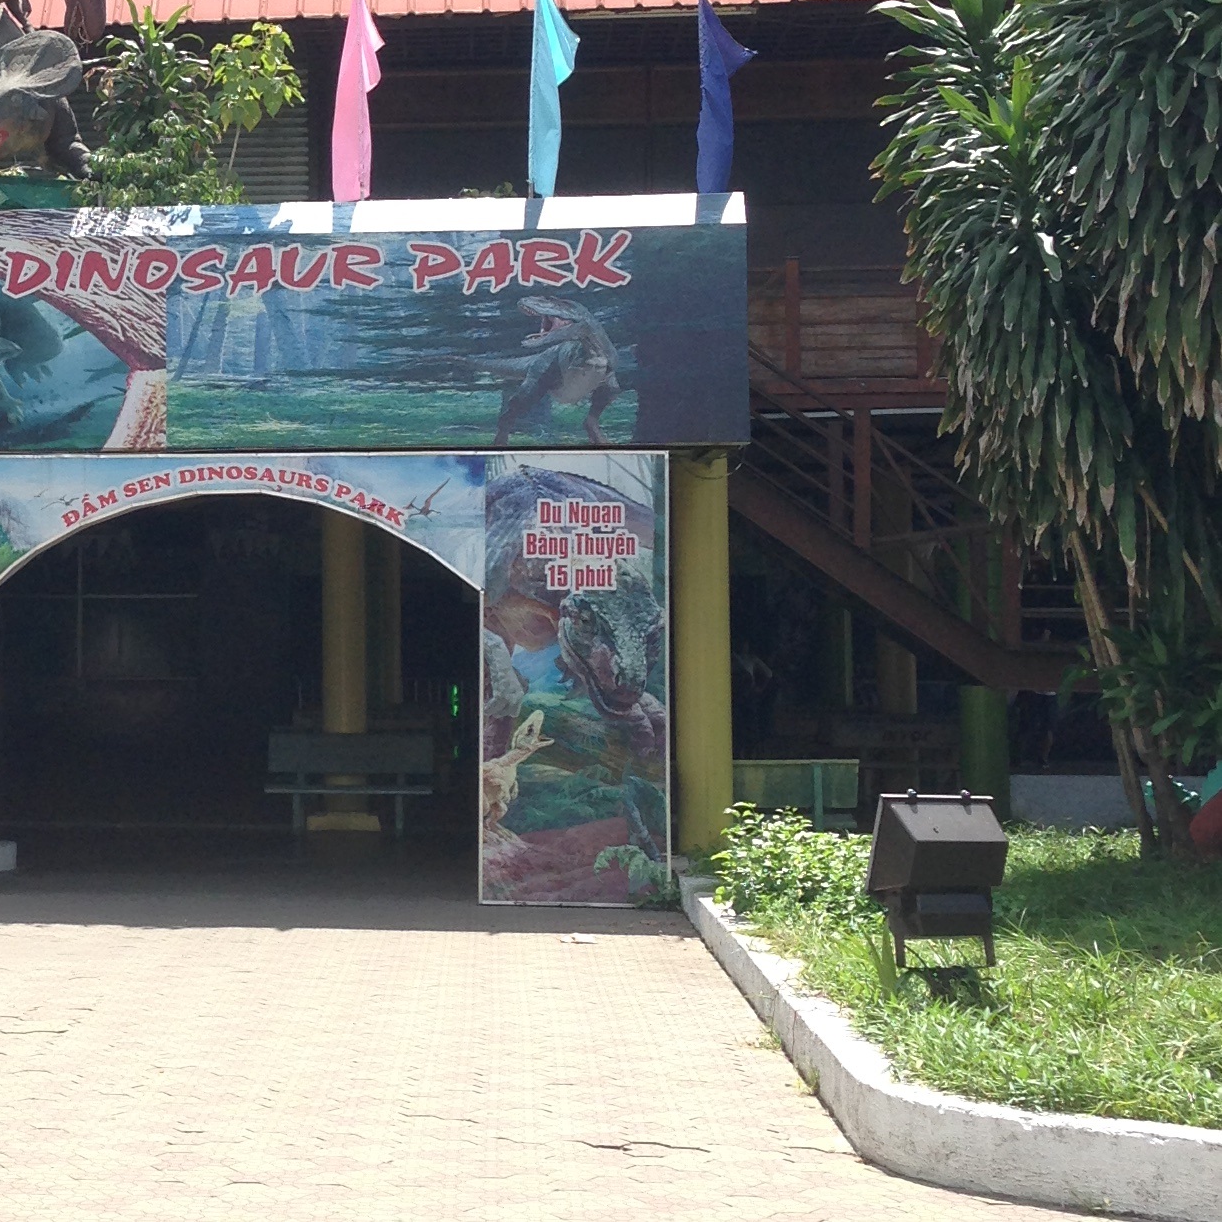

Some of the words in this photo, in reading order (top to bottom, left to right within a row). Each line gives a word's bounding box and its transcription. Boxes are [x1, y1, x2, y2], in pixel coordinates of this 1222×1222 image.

[1, 242, 384, 297] DINOSAUR
[407, 230, 632, 294] PARK
[61, 490, 118, 527] ĐẦM
[124, 473, 171, 497] SEN
[178, 465, 329, 493] DINOSAURS
[333, 483, 405, 526] PARK
[540, 502, 561, 523] Du
[569, 502, 622, 528] Ngoạn
[548, 565, 568, 587] 15
[575, 564, 614, 591] phút
